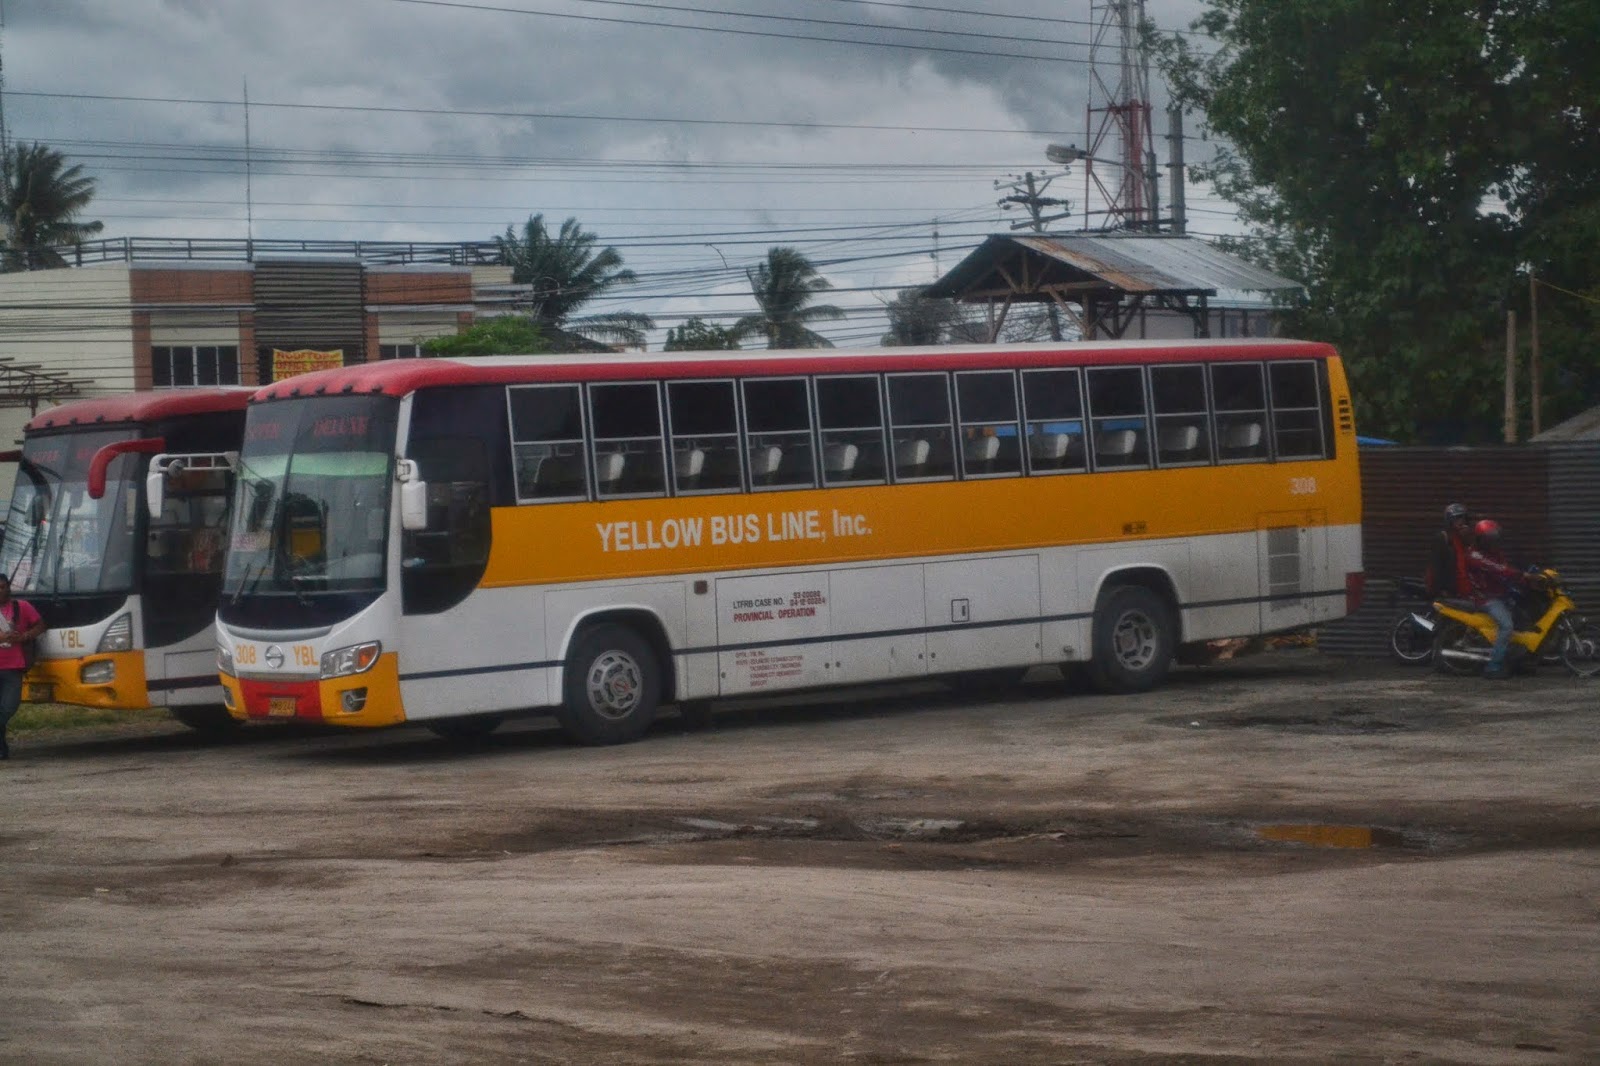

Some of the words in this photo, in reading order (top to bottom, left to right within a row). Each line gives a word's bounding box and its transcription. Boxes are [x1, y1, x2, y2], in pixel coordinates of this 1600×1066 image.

[1289, 477, 1316, 495] 308
[596, 517, 703, 551] YELLOW
[710, 513, 760, 545] BUS
[767, 510, 827, 543] LINE,
[832, 509, 873, 537] Inc.
[733, 599, 754, 609] LTFRB
[754, 598, 772, 608] CASE
[773, 597, 785, 606] NO.
[733, 610, 774, 622] PROVINCIAL
[778, 607, 816, 619] OPERATION
[59, 629, 85, 648] YBL
[236, 645, 257, 665] 308
[292, 646, 319, 666] YBL
